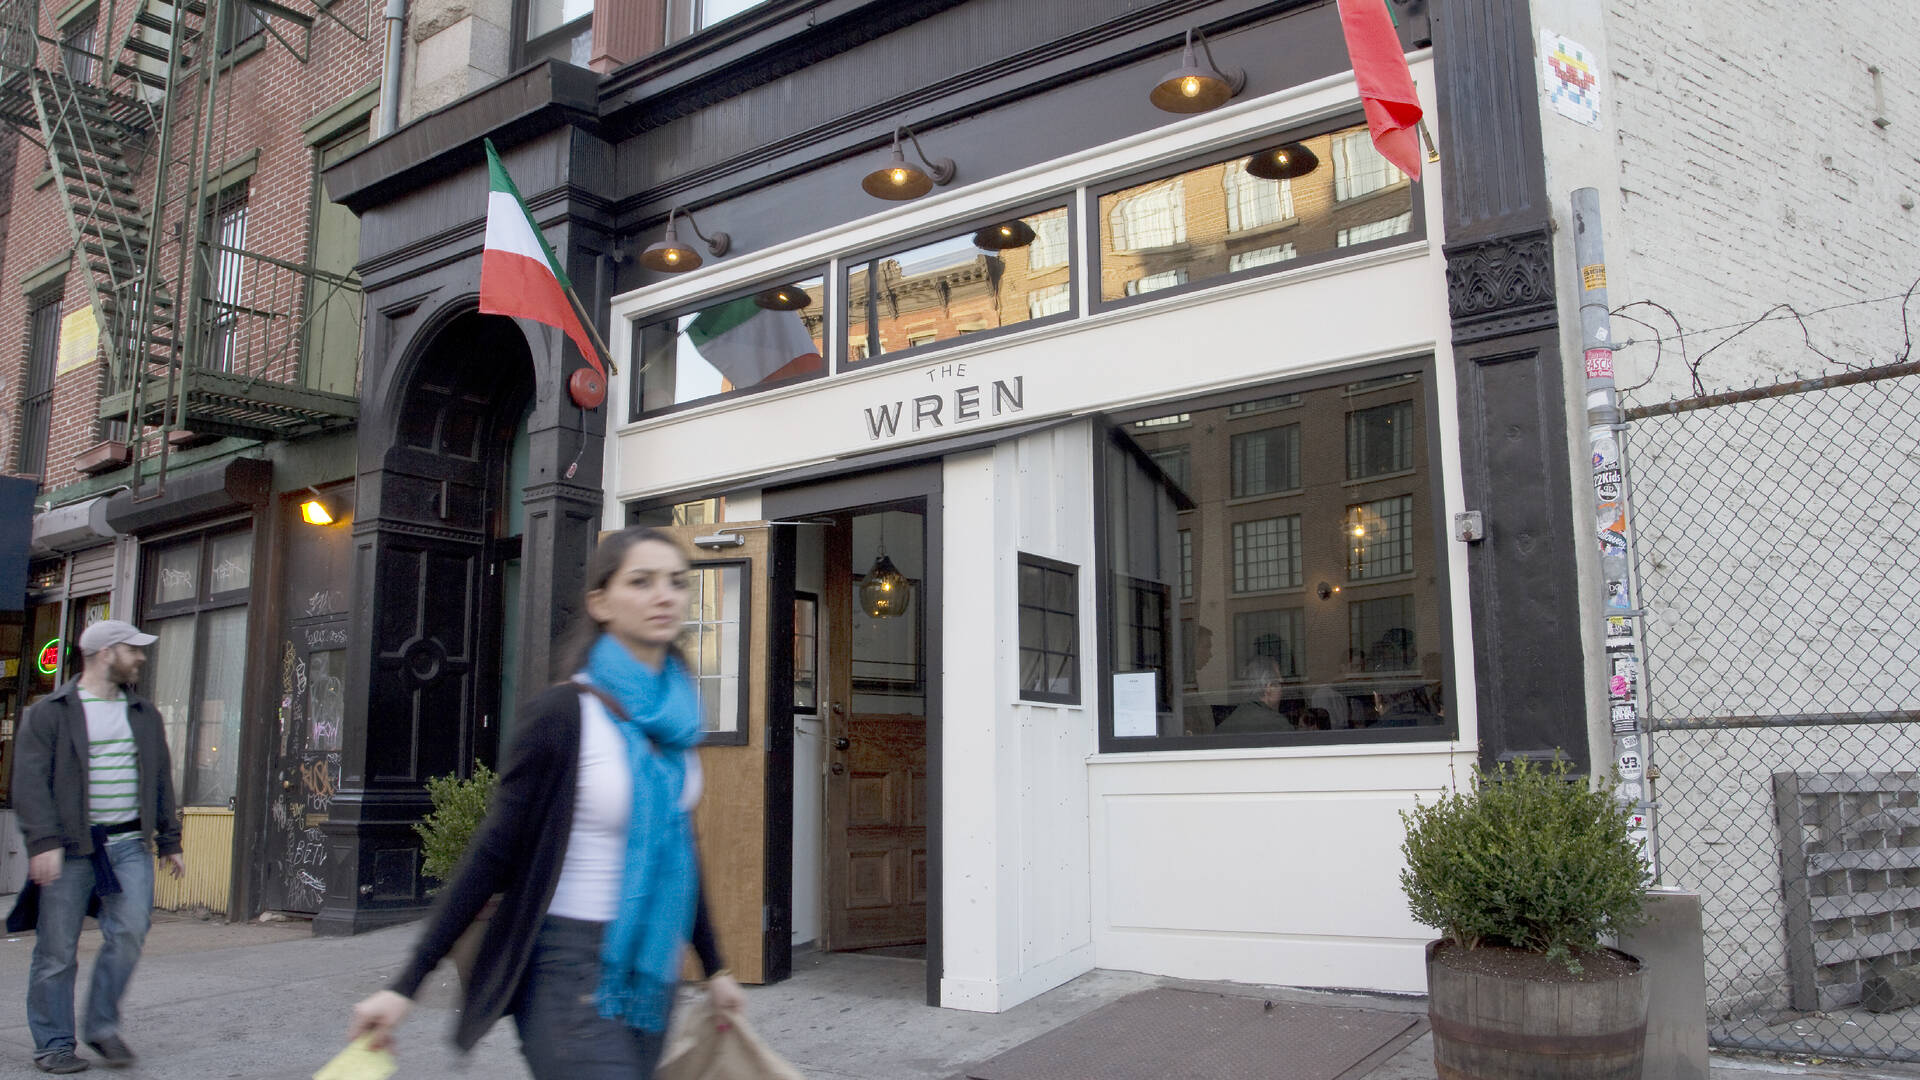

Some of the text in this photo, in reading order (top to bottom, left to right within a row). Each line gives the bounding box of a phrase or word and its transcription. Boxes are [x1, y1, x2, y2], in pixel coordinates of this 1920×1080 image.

[926, 363, 967, 383] THE
[863, 375, 1023, 440] WREN
[41, 647, 58, 665] OPE
